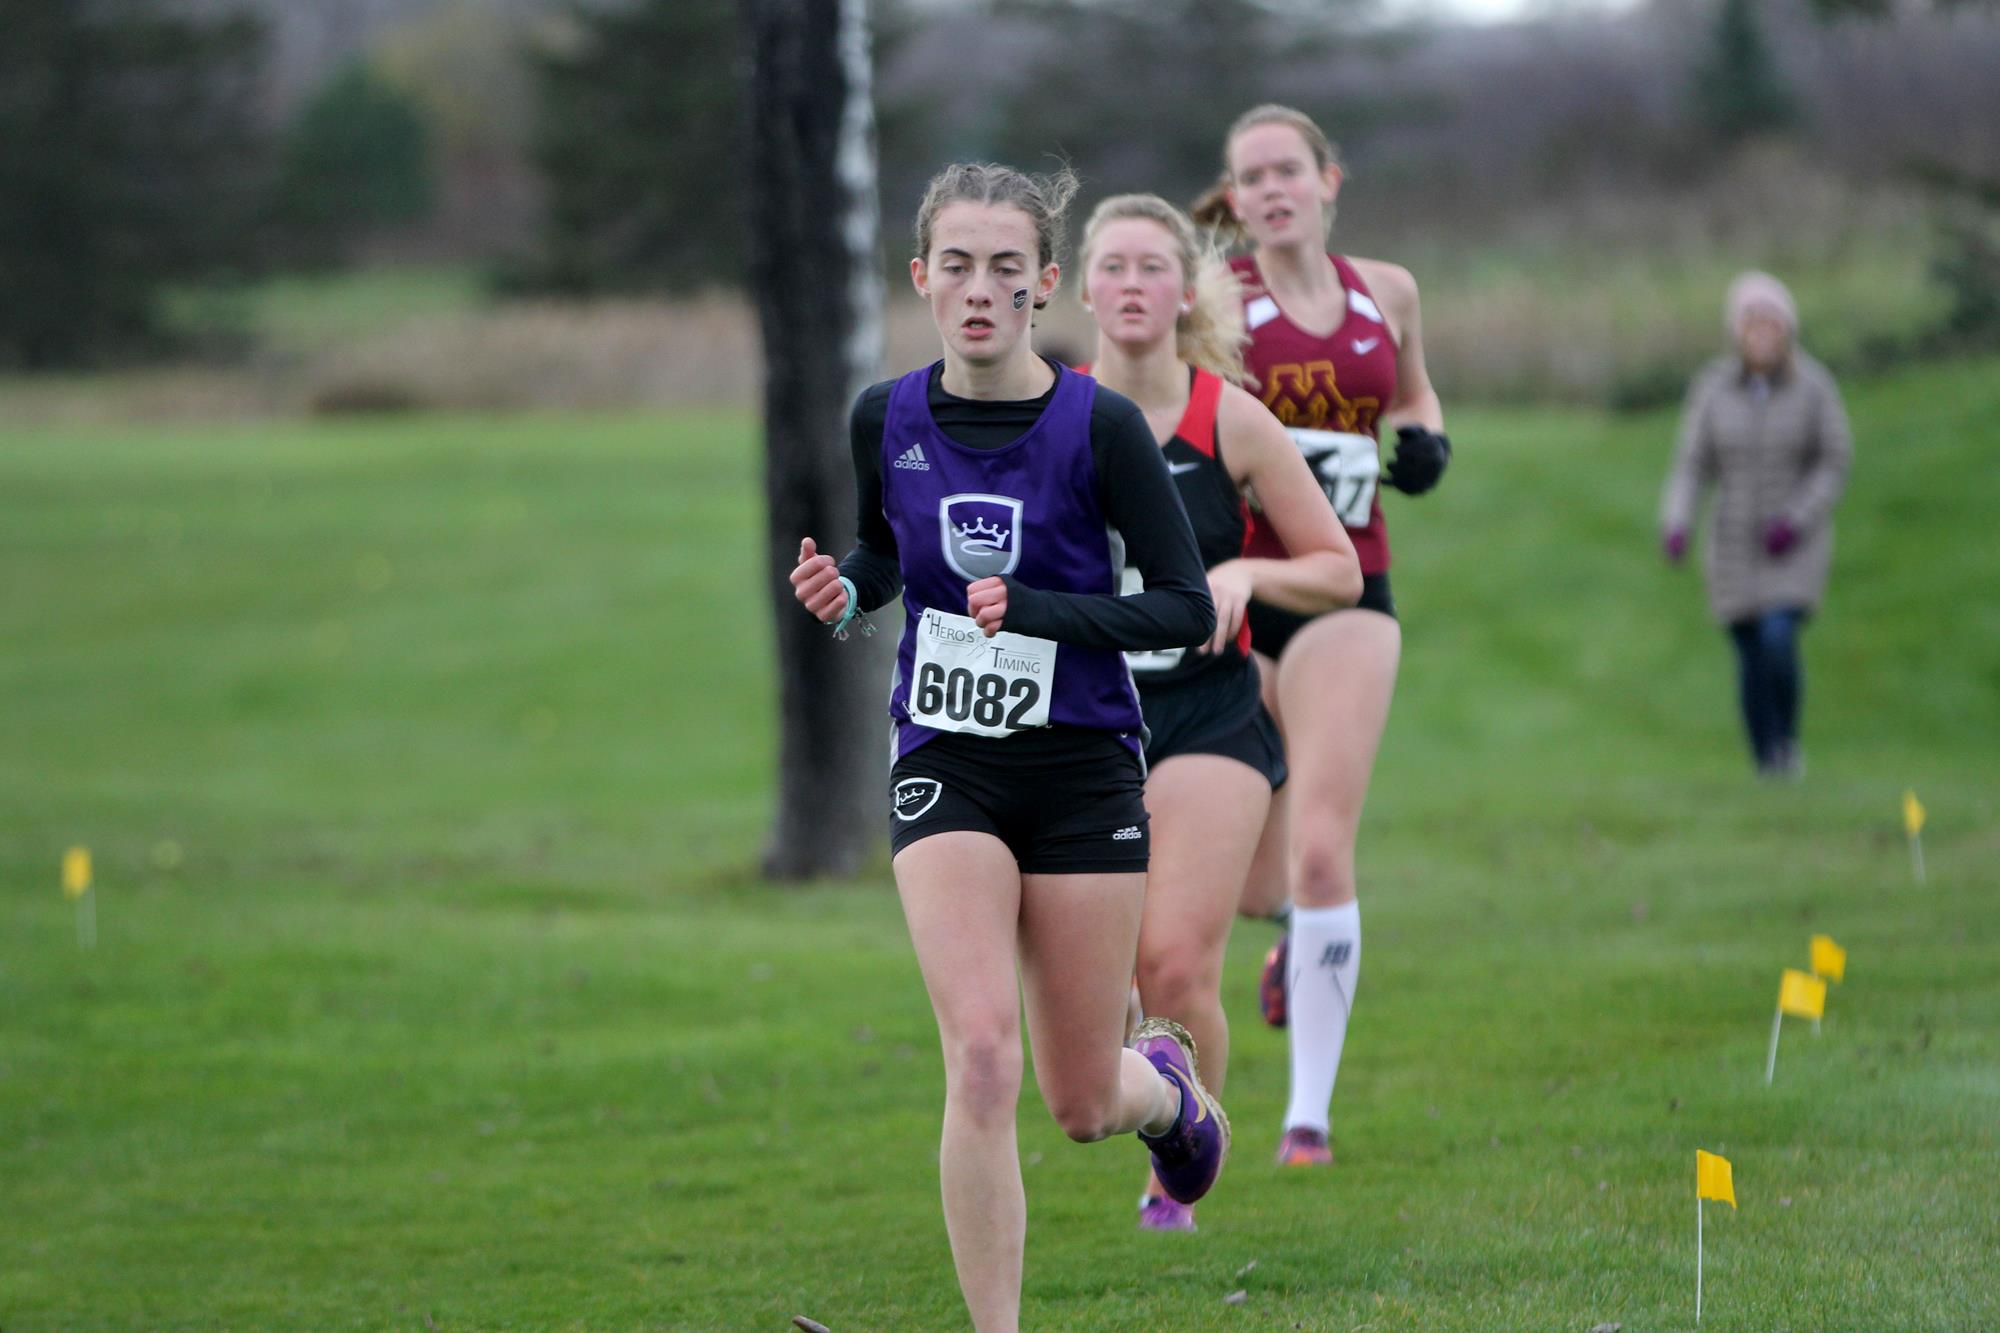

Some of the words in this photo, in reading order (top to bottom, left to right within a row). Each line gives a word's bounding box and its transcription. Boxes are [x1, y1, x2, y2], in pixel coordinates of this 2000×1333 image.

[894, 460, 930, 471] adidas
[916, 662, 1040, 729] 6082
[1113, 831, 1142, 840] adidas
